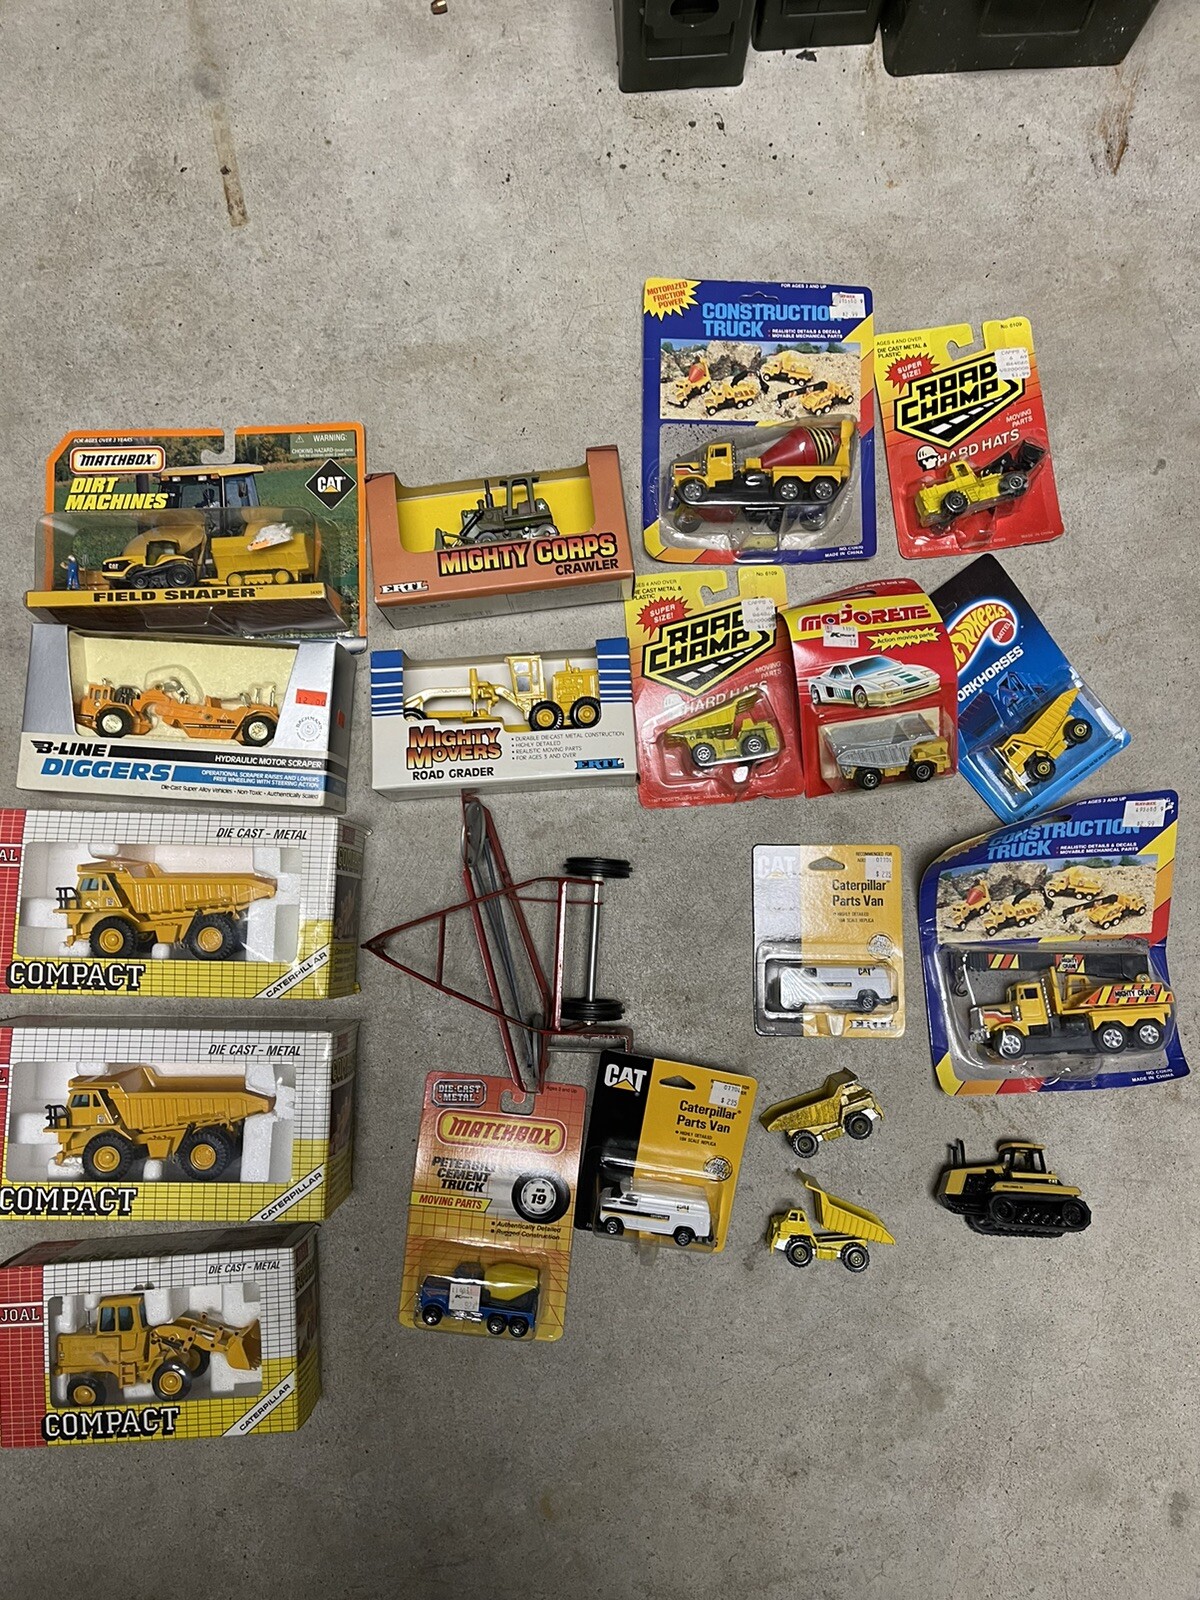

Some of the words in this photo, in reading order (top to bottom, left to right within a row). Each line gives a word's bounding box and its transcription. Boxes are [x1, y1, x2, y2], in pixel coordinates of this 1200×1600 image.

[646, 281, 688, 296] MOTORIZED
[653, 289, 686, 303] FRICTION
[658, 297, 684, 309] POWER
[702, 303, 842, 322] CONSTRUCTIO
[702, 320, 765, 338] TRUCK
[897, 360, 923, 374] SUPER
[902, 368, 922, 380] SIZE!
[915, 360, 998, 400] ROAD
[902, 378, 998, 427] CHAMP
[1006, 408, 1032, 424] MOVING
[1012, 416, 1034, 428] PARTS
[313, 433, 348, 442] WARNING:
[936, 443, 979, 468] HARD
[982, 429, 1020, 452] HATS
[80, 454, 155, 466] MATCHBOX
[70, 477, 120, 494] DIRT
[317, 476, 343, 493] CAT
[64, 493, 169, 510] MACHINES
[439, 543, 531, 576] MIGHTY
[535, 533, 617, 565] CORPS
[555, 558, 619, 576] CRAWLER
[381, 580, 429, 594] ERTL
[93, 592, 156, 602] FIELD
[164, 588, 256, 600] SHAPER
[650, 604, 676, 618] SUPER
[654, 612, 674, 624] SIZE!
[650, 631, 750, 673] CHAMP
[755, 661, 782, 674] MOVING
[761, 668, 782, 679] PARTS
[957, 645, 1024, 702] ORKHORSES
[683, 692, 726, 714] HARD
[31, 740, 107, 758] B-LINE
[215, 754, 258, 765] HYDRAULIC
[258, 757, 286, 766] MOTOR
[287, 758, 322, 768] SCRAPER
[574, 758, 624, 770] ERTL
[40, 758, 172, 782] DIGGERS
[201, 770, 238, 778] OPERATIONAL
[412, 770, 444, 780] ROAD
[449, 767, 494, 778] GRADER
[267, 790, 302, 798] Authentically
[216, 828, 234, 838] DIE
[236, 828, 264, 838] CAST
[273, 829, 308, 840] METAL
[987, 840, 1052, 860] TRUCK
[832, 879, 886, 893] Caterpillar
[832, 895, 861, 906] Parts
[863, 895, 884, 906] Van
[7, 962, 146, 990] COMPACT
[265, 951, 328, 998] CATERPILLAR
[858, 968, 871, 976] CAT
[208, 1044, 227, 1055] DIE
[228, 1044, 257, 1055] CAST
[266, 1045, 301, 1056] METAL
[604, 1063, 648, 1093] CAT
[443, 1093, 475, 1102] METAL
[680, 1100, 737, 1120] Caterpillar
[448, 1116, 557, 1146] MATCHBOX
[676, 1114, 706, 1130] Parts
[710, 1120, 731, 1134] Van
[436, 1167, 491, 1183] CEMENT
[441, 1178, 485, 1192] TRUCK
[0, 1187, 138, 1216] COMPACT
[260, 1172, 323, 1221] CATERPILLAR
[418, 1194, 454, 1207] MOVING
[454, 1198, 482, 1210] PARTS
[531, 1194, 547, 1205] 19
[496, 1222, 536, 1231] Authentically
[536, 1225, 562, 1233] Detailed
[496, 1229, 520, 1237] Rugged
[521, 1231, 560, 1240] Construction
[208, 1264, 222, 1274] DIE
[224, 1262, 246, 1274] CAST
[253, 1261, 280, 1272] METAL
[0, 1308, 40, 1322] JOAL
[239, 1383, 291, 1432] CATERPILLAR
[42, 1406, 180, 1440] COMPACT
